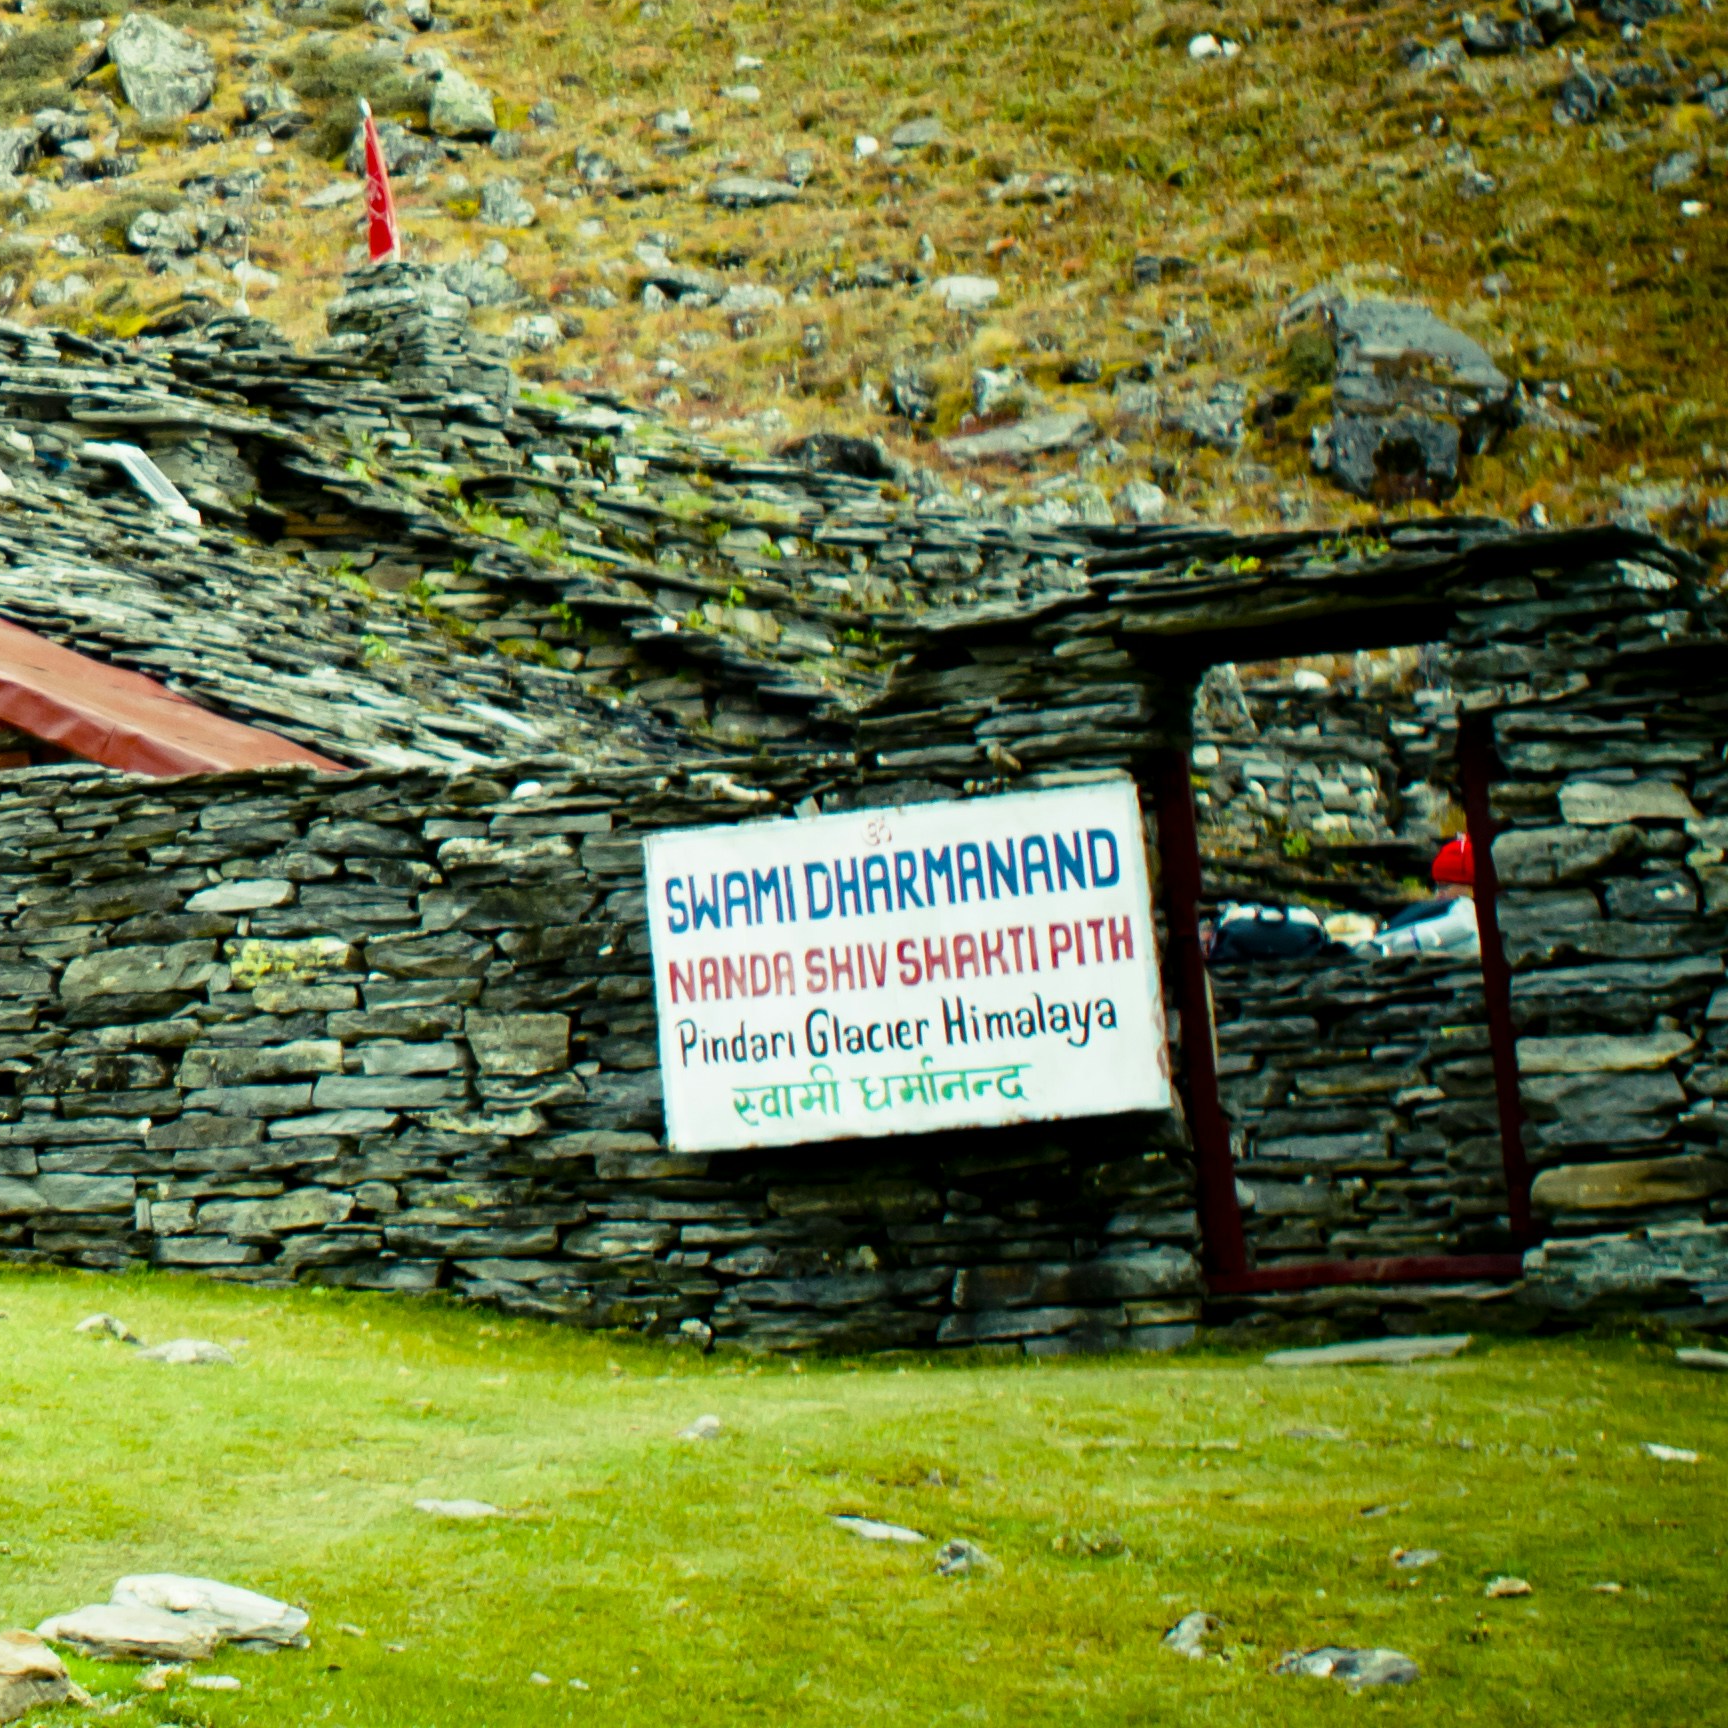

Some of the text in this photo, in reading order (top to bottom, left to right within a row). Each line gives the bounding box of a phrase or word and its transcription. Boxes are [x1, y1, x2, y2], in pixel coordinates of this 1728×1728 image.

[665, 828, 1120, 934] SWAMI DHARMANAND
[669, 915, 1136, 1003] NANDA SHIV SHAKTI PITH
[675, 992, 1118, 1068] Pindari Glacier Himalaya
[731, 1056, 1034, 1127] स्वामी धर्मानन्द
